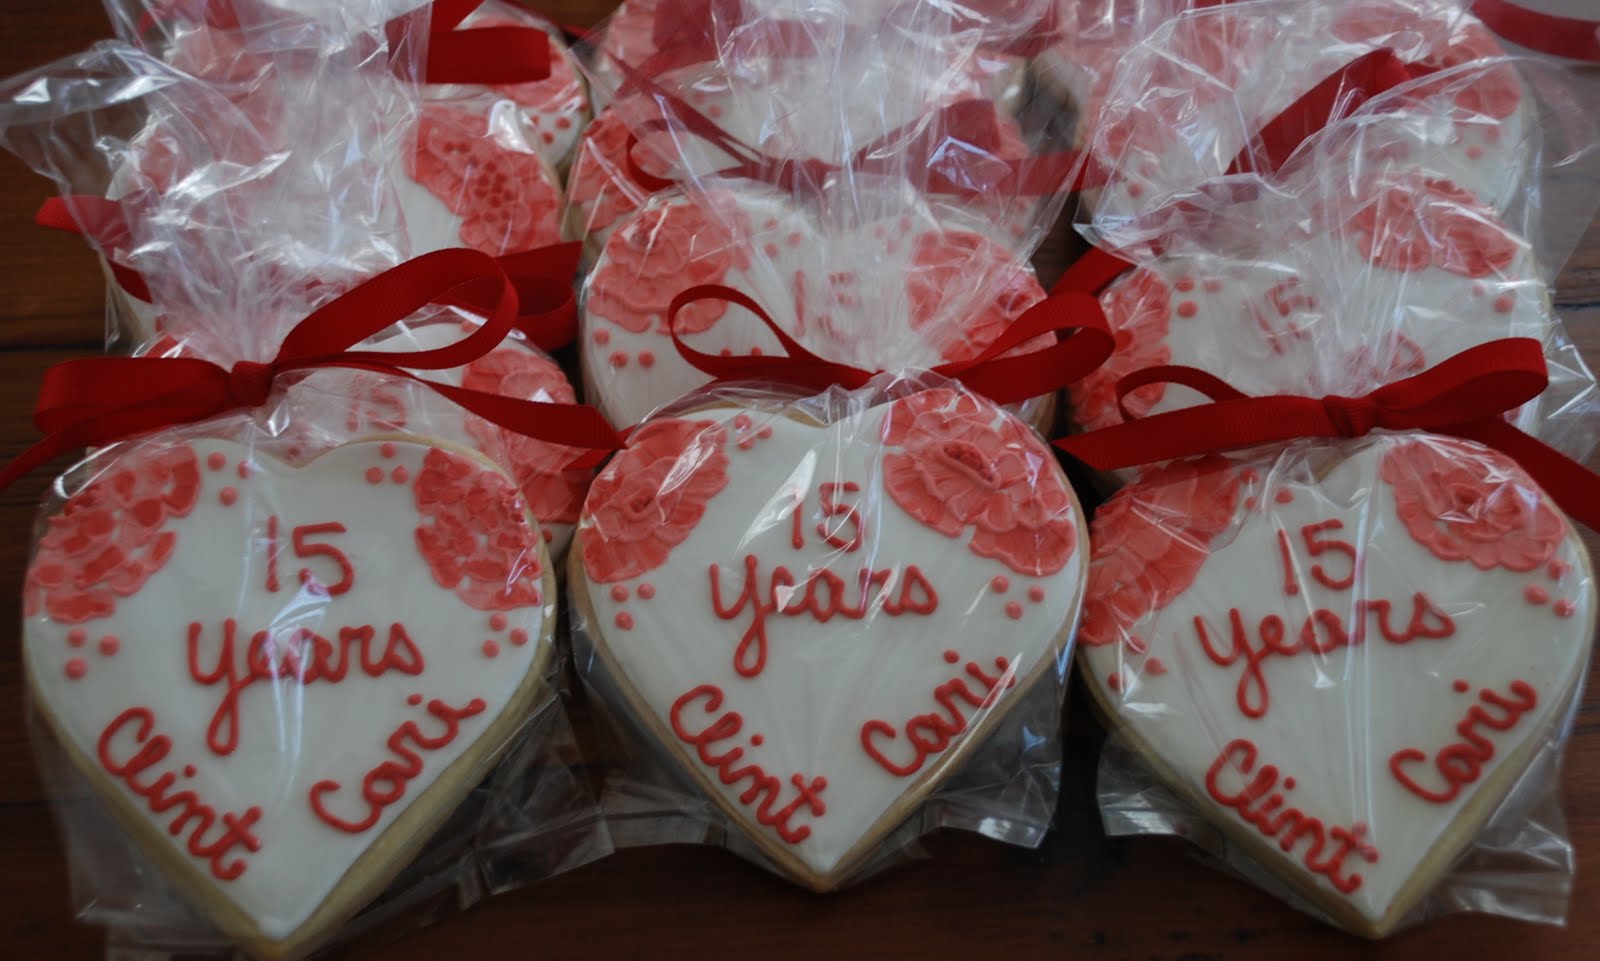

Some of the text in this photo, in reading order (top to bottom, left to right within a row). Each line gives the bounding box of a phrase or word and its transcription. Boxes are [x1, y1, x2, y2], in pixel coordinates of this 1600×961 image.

[266, 515, 354, 596] 15
[791, 481, 862, 552] 15
[1277, 518, 1361, 595] 15
[97, 707, 262, 881] Clint
[309, 694, 486, 833] Cari
[670, 685, 827, 844] Clint
[1389, 679, 1538, 804] Cari
[1206, 739, 1379, 894] Clint
